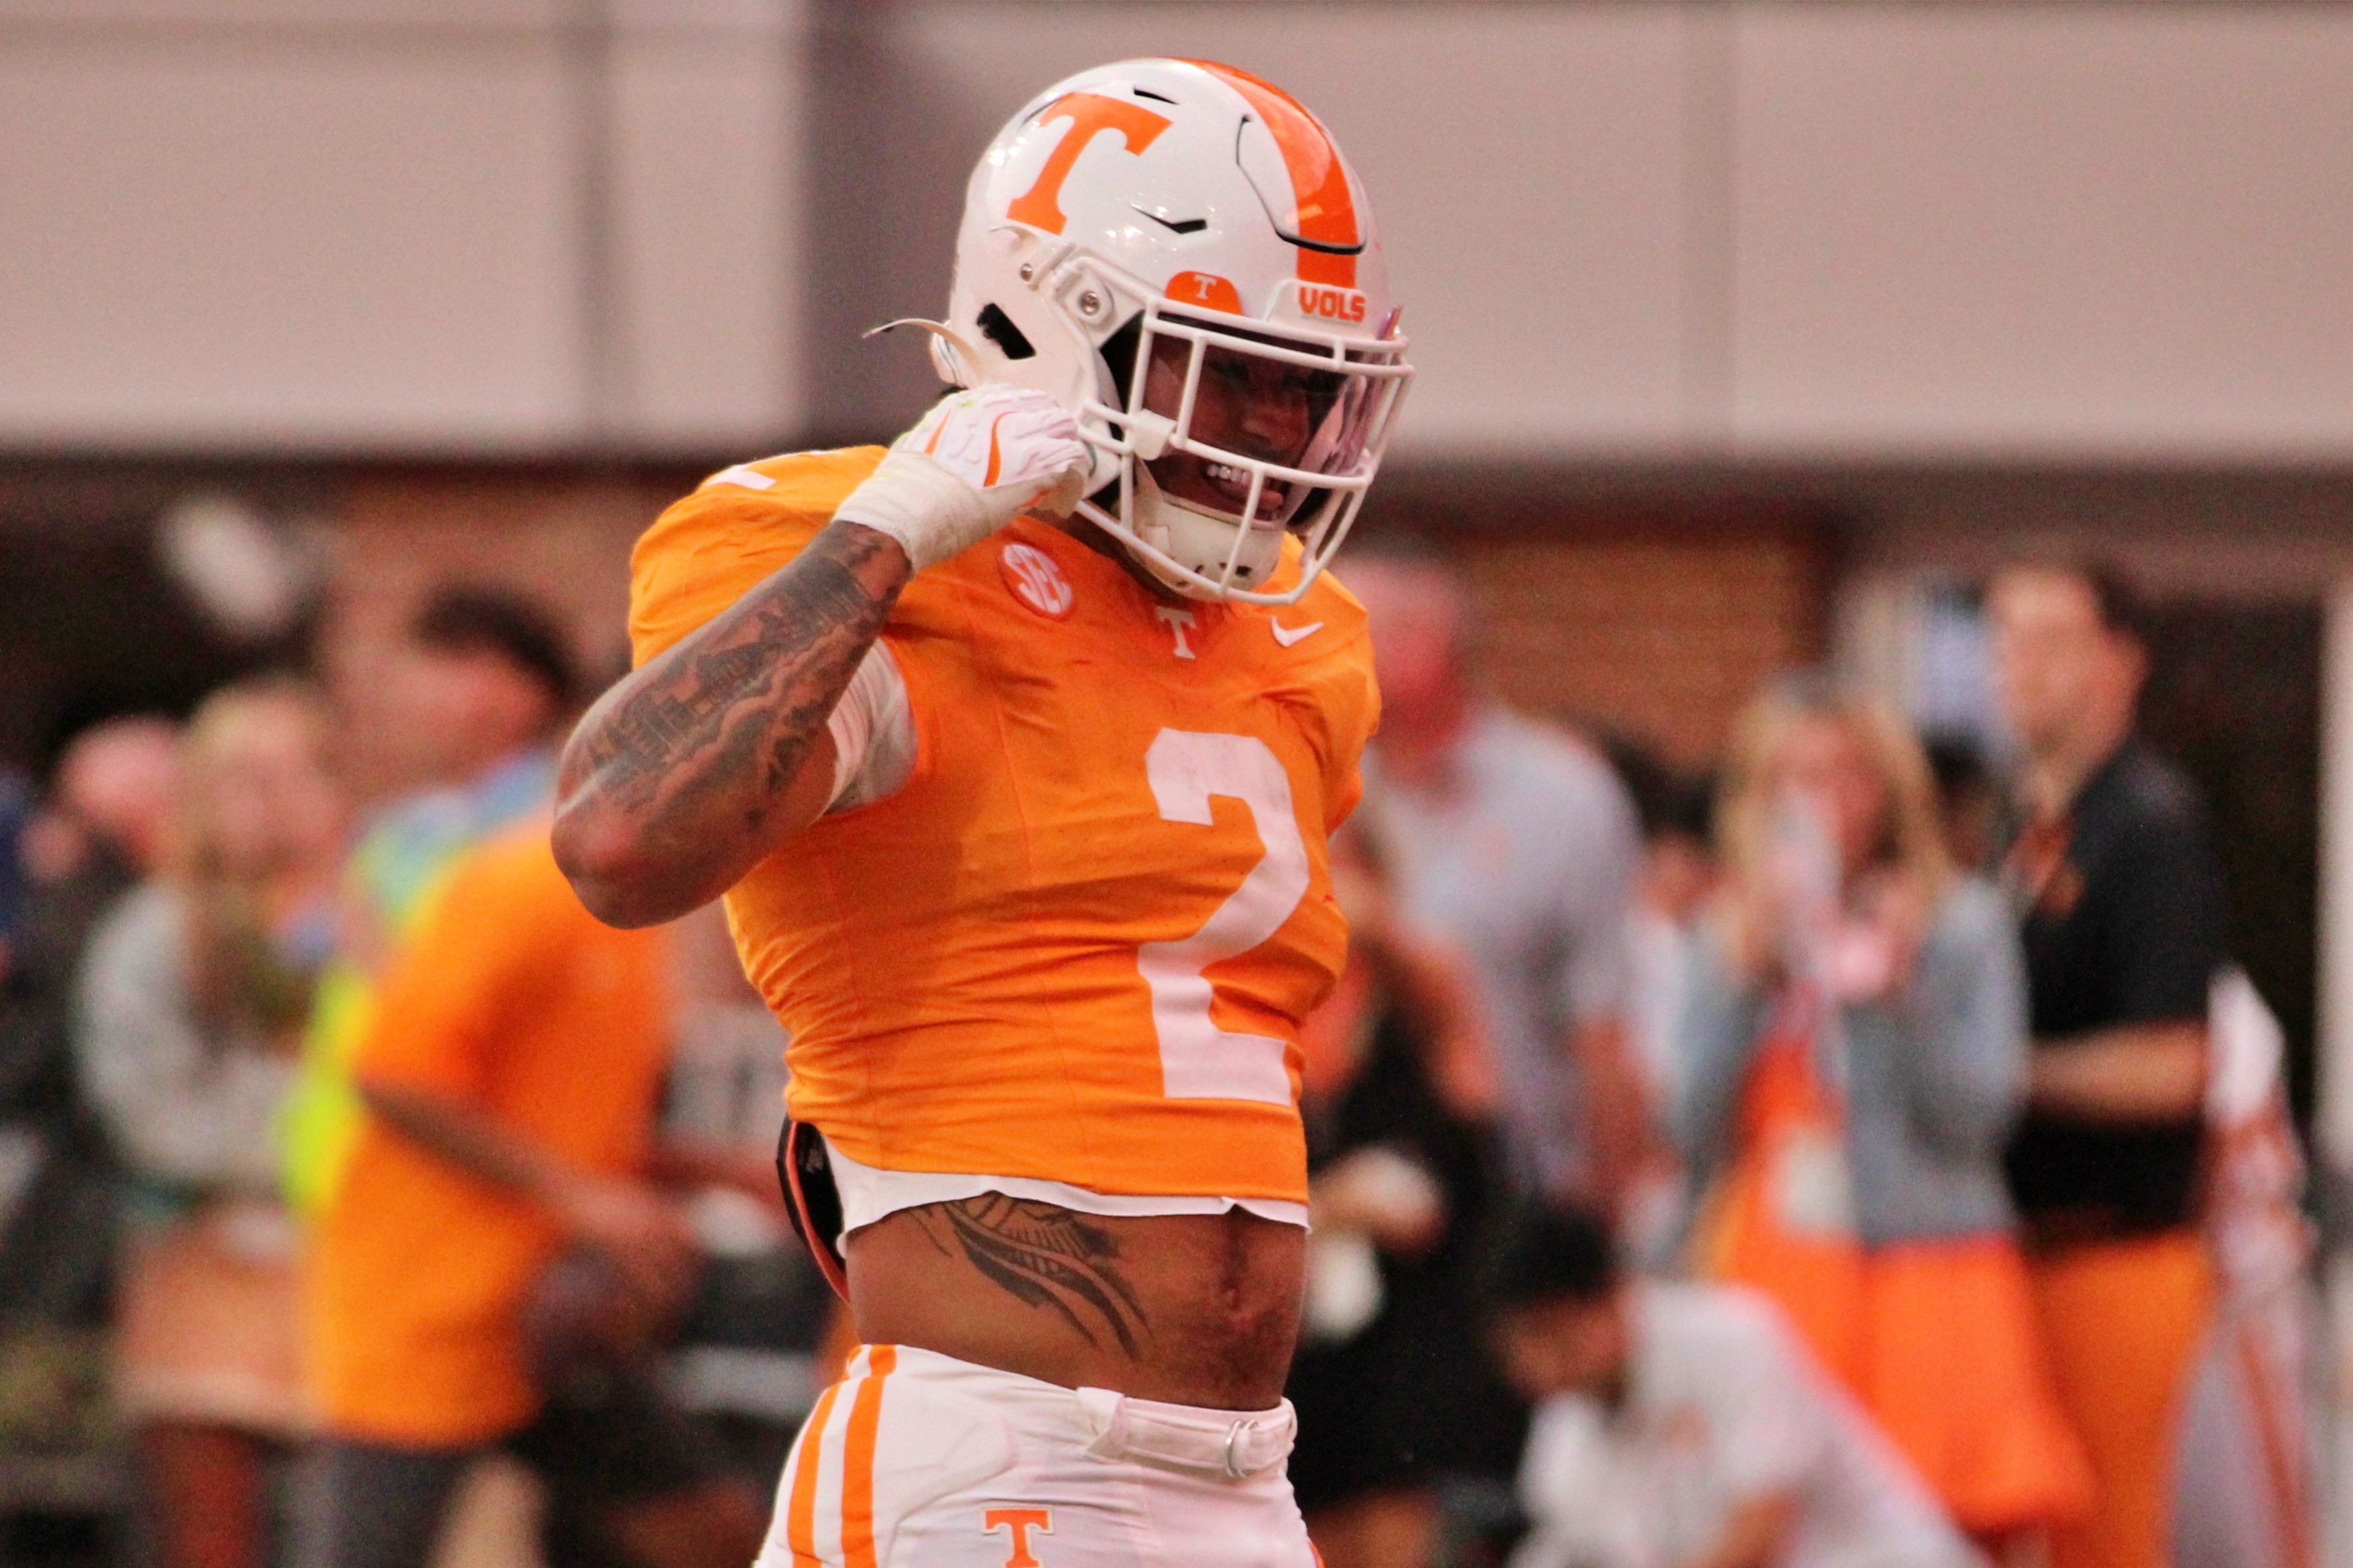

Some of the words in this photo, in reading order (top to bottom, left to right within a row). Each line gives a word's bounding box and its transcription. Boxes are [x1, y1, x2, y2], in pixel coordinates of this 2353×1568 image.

[1006, 92, 1173, 235] T
[1195, 273, 1217, 300] T
[1299, 286, 1366, 323] VOLS
[1156, 606, 1196, 659] T
[1138, 727, 1309, 1106] 2
[985, 1509, 1049, 1568] T
